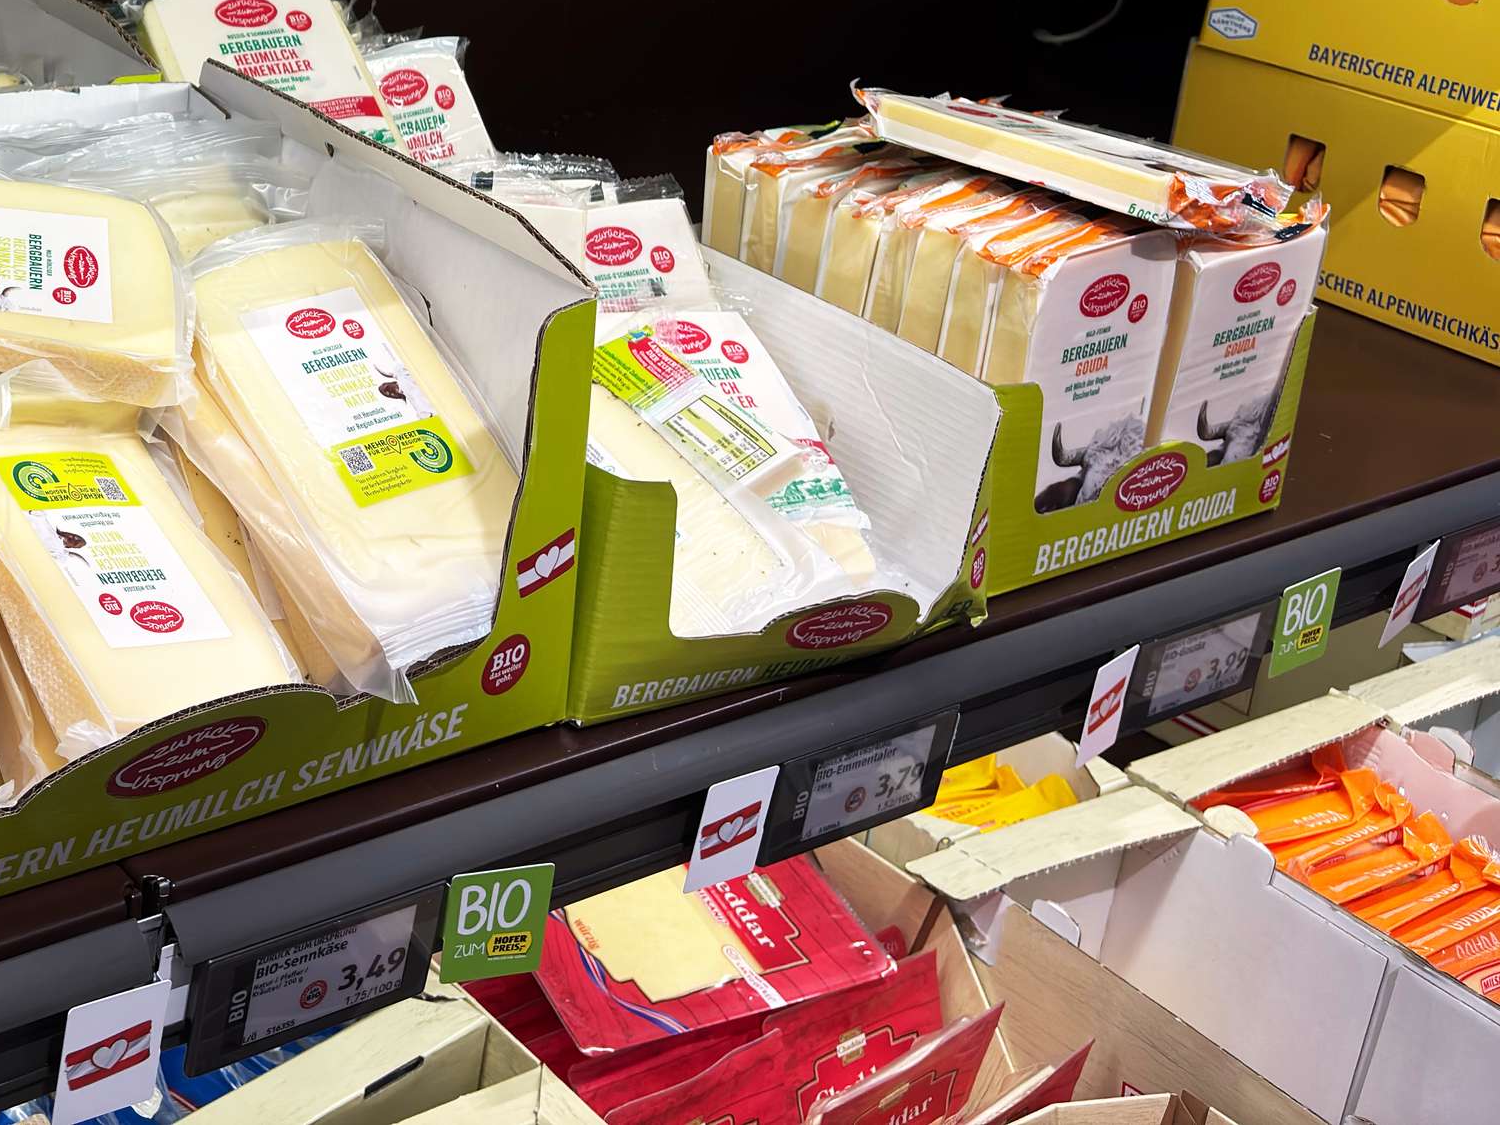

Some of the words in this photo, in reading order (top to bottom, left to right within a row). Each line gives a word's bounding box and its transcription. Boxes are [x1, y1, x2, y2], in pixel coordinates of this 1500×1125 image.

[219, 34, 302, 55] BERGBAUERN
[233, 51, 299, 66] HEUMILCH
[1309, 44, 1415, 88] BAYERISCHER
[29, 234, 42, 290] BERGBAUERN
[653, 251, 671, 261] BIO
[1213, 316, 1275, 347] BERGBAUERN
[1366, 288, 1500, 350] ALPENWEICHKÄS
[302, 348, 368, 374] BERGBAUERN
[1061, 333, 1128, 364] BERGBAUERN
[1224, 336, 1256, 358] GOUDA
[1076, 355, 1109, 377] GOUDA
[365, 439, 386, 452] MEHR
[1034, 516, 1172, 576] BERGBAUERN
[1177, 489, 1236, 531] GOUDA
[96, 569, 167, 585] BERGBAUERN
[1283, 583, 1328, 636] BIO
[491, 644, 528, 673] BIO
[1206, 647, 1248, 680] 3,99
[611, 666, 759, 708] BERGBAUERN
[817, 747, 898, 782] BIO-Emmentaler
[875, 763, 925, 798] 3,79
[90, 771, 289, 862] HEUMILCH
[291, 703, 468, 790] SENNKÄSE
[793, 791, 809, 820] BIO
[457, 879, 532, 936] BIO
[255, 940, 349, 980] BIO-Sennkäse
[454, 941, 486, 959] ZUM
[494, 934, 528, 945] HOFER
[338, 948, 405, 992] 3,49
[229, 989, 248, 1025] BIO
